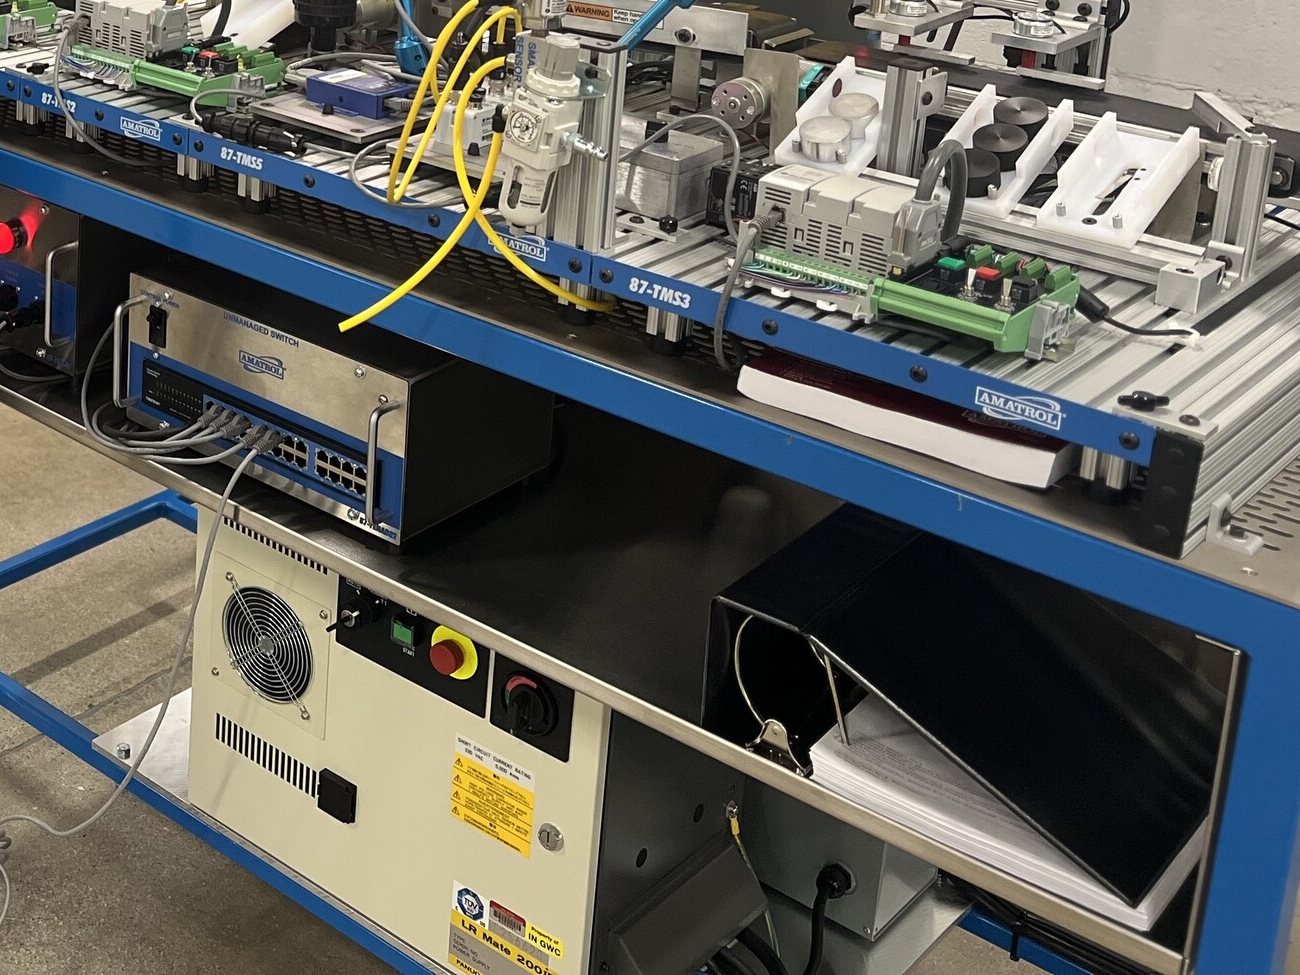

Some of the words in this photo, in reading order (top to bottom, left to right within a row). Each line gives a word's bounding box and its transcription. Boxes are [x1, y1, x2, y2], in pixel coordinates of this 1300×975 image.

[574, 6, 610, 18] WARNING
[614, 9, 628, 17] Keep
[514, 36, 525, 83] SENSOR
[122, 120, 160, 138] AMATROL
[220, 146, 264, 171] 87-TMS5
[628, 277, 691, 309] 87-TMS3
[223, 311, 269, 336] UNMANAGED
[270, 330, 300, 348] SWITCH
[241, 354, 282, 376] AMATROL
[979, 392, 1057, 425] AMATROL
[514, 767, 531, 780] RATING
[462, 919, 477, 935] LR
[482, 932, 511, 956] Mate
[528, 933, 538, 944] IN
[539, 939, 561, 957] GWC
[531, 926, 553, 943] Property
